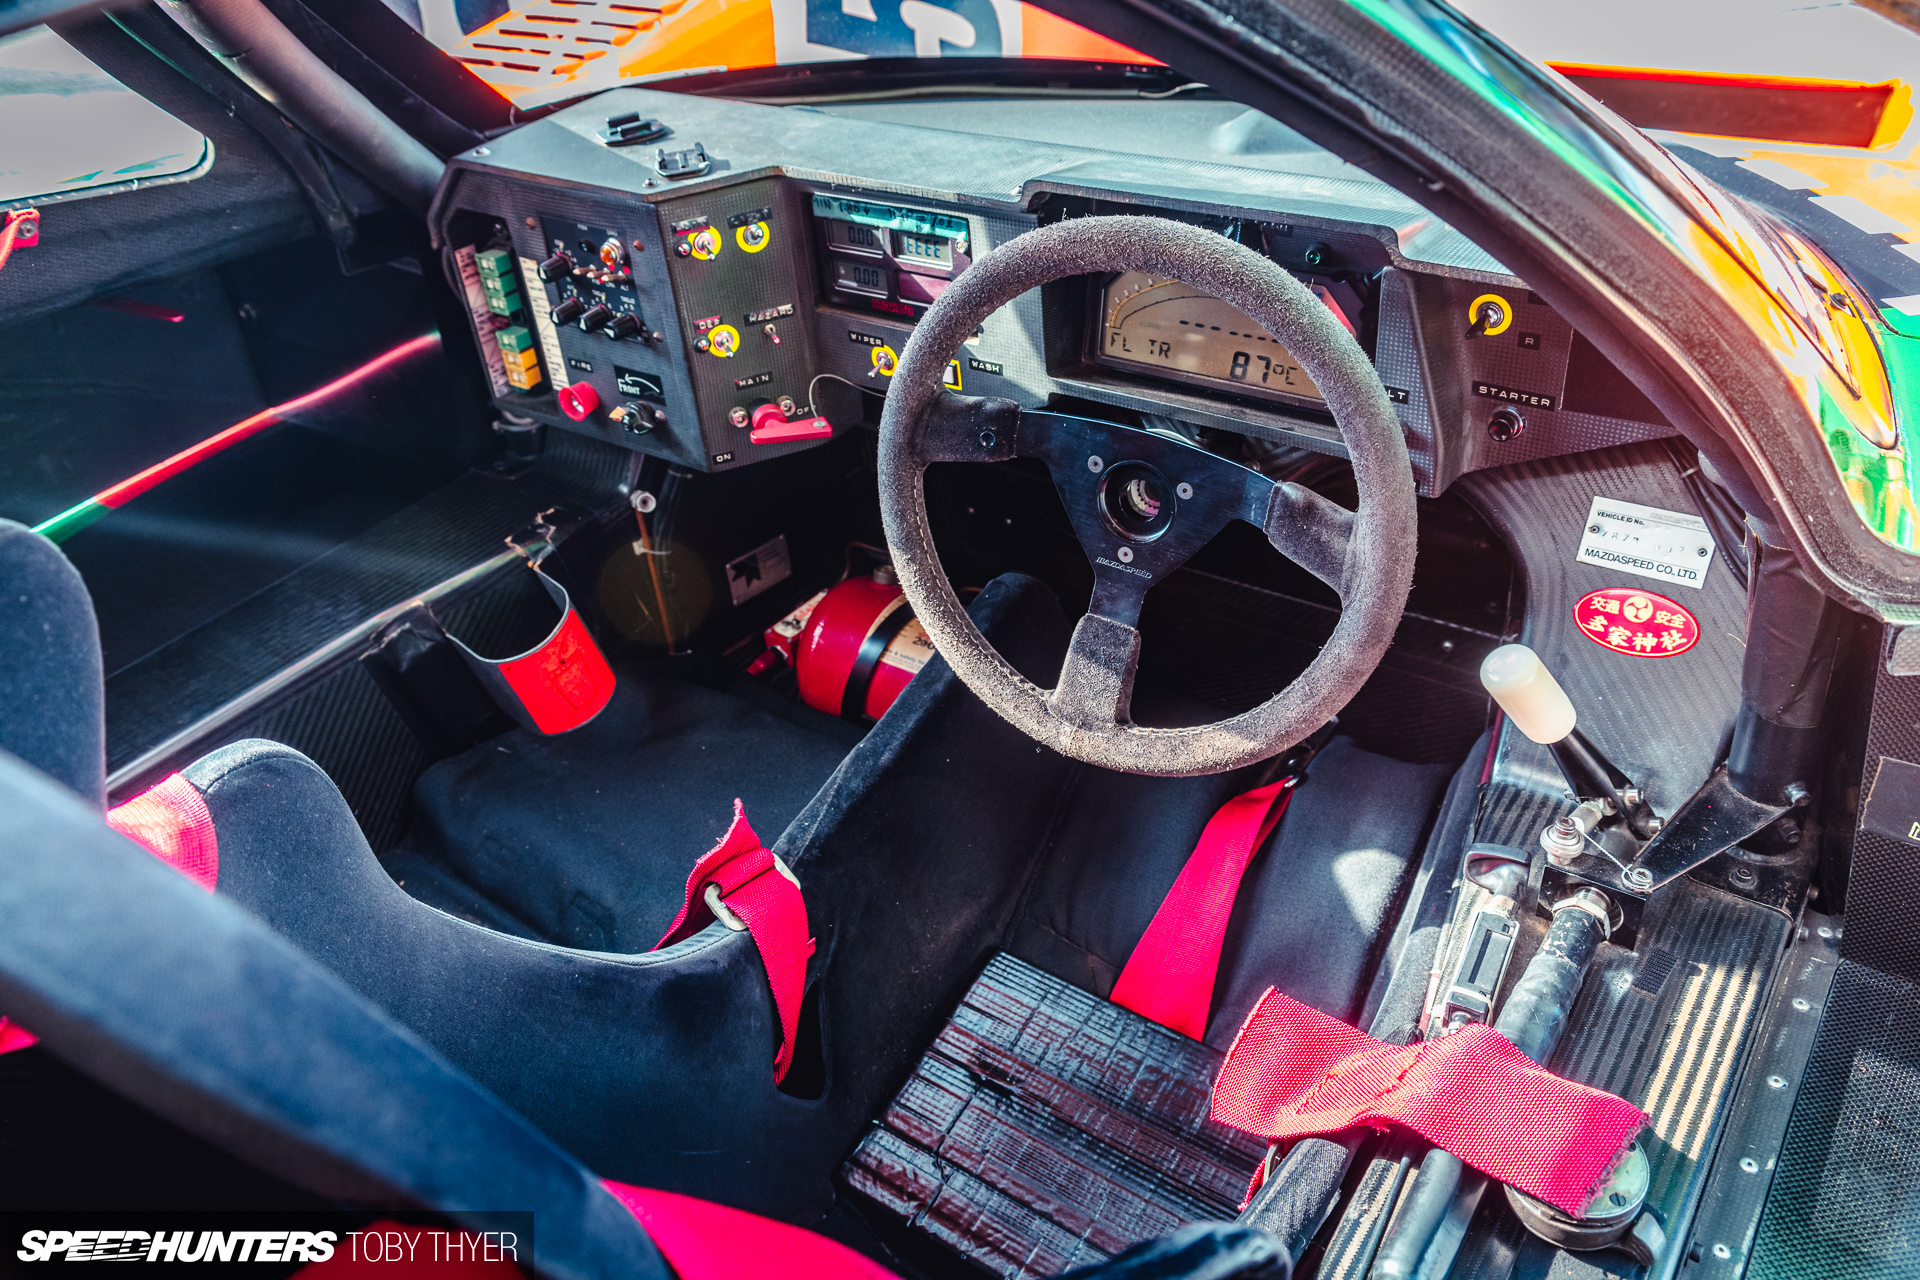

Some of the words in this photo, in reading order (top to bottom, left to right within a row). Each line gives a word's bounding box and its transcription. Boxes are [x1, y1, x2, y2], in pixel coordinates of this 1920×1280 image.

[848, 226, 874, 247] 0.00
[854, 266, 879, 287] 0.00
[850, 332, 882, 347] WIPER
[1110, 332, 1132, 353] FL
[1149, 339, 1171, 359] TR
[1524, 337, 1534, 345] R
[971, 359, 1000, 373] WASH
[617, 378, 641, 395] FRONT
[739, 374, 769, 387] MAIN
[1478, 385, 1551, 407] STARTER
[716, 453, 732, 462] ON
[1597, 511, 1625, 522] VEHICLE
[1095, 556, 1153, 579] MAZDASPEED
[1584, 547, 1655, 571] MAZDASPEED
[1677, 568, 1698, 581] LTD.
[1589, 596, 1621, 615] 交通
[1653, 610, 1687, 629] 安全
